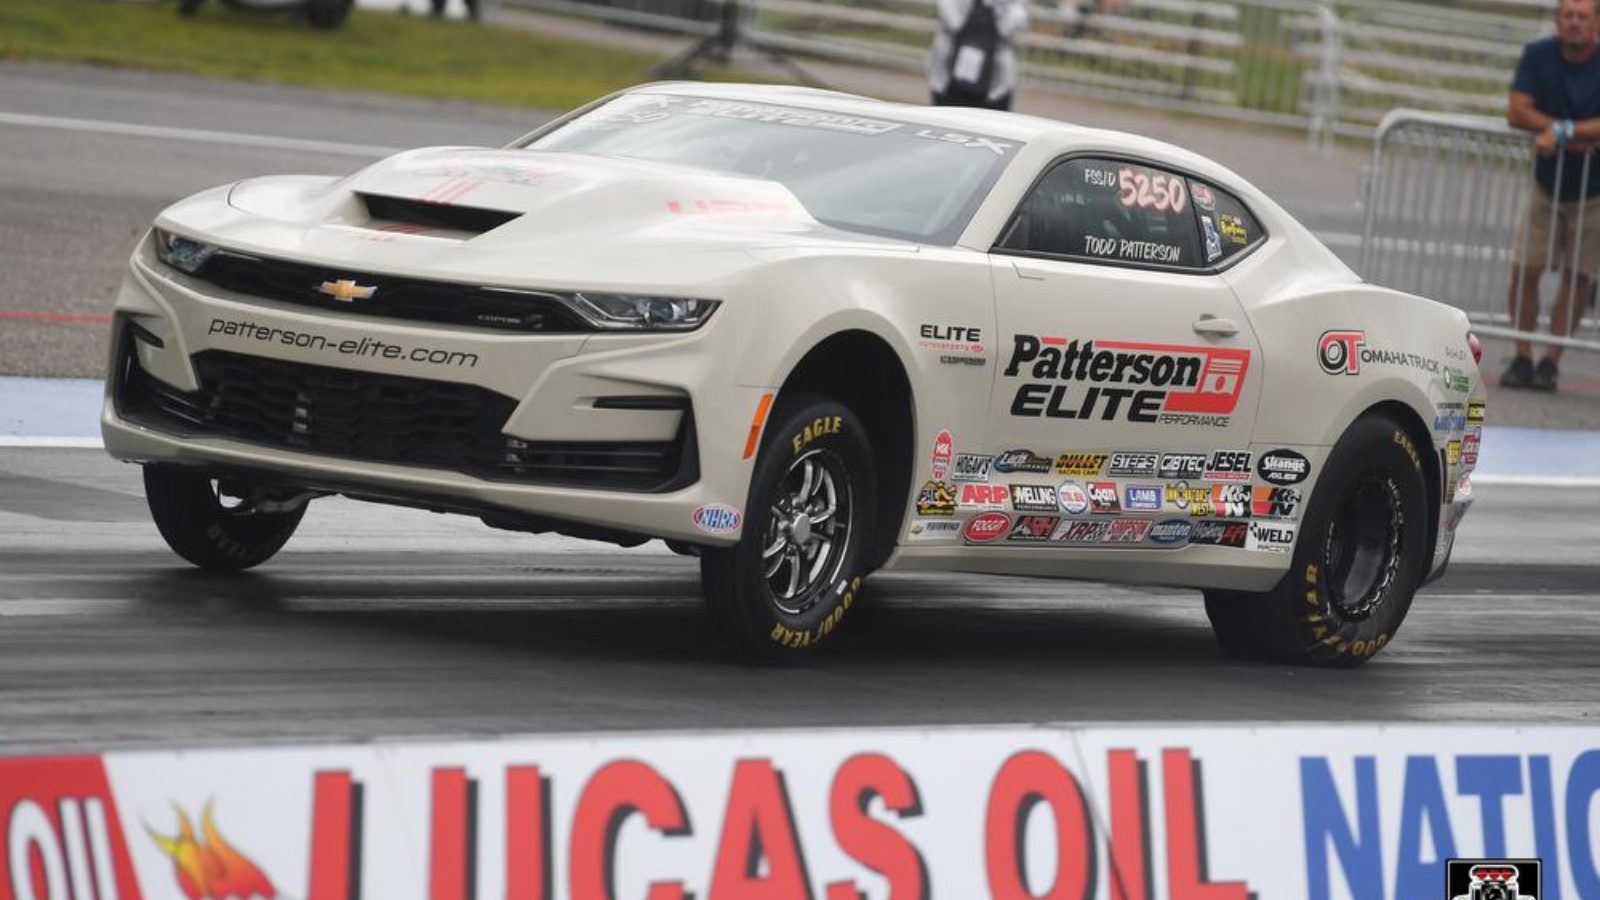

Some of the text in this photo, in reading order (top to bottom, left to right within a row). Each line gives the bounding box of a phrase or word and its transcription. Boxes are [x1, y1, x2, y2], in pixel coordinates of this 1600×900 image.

[1118, 168, 1186, 214] 5250
[1084, 235, 1181, 263] TODD PATTERSON
[208, 316, 479, 368] patterson-elite.com
[920, 324, 981, 342] ELITE
[1003, 334, 1201, 387] Patterson
[1010, 383, 1167, 423] ELITE
[1158, 412, 1230, 428] PERFORMANCE
[793, 415, 842, 454] EAGLE
[1055, 453, 1107, 470] BULLET
[1206, 451, 1251, 473] JESEL
[961, 484, 1009, 503] ARP
[1016, 485, 1058, 505] MELLING
[1129, 488, 1156, 502] LAMB
[698, 508, 738, 529] NHRA
[1258, 527, 1294, 544] WELD
[984, 748, 1258, 900] OIL
